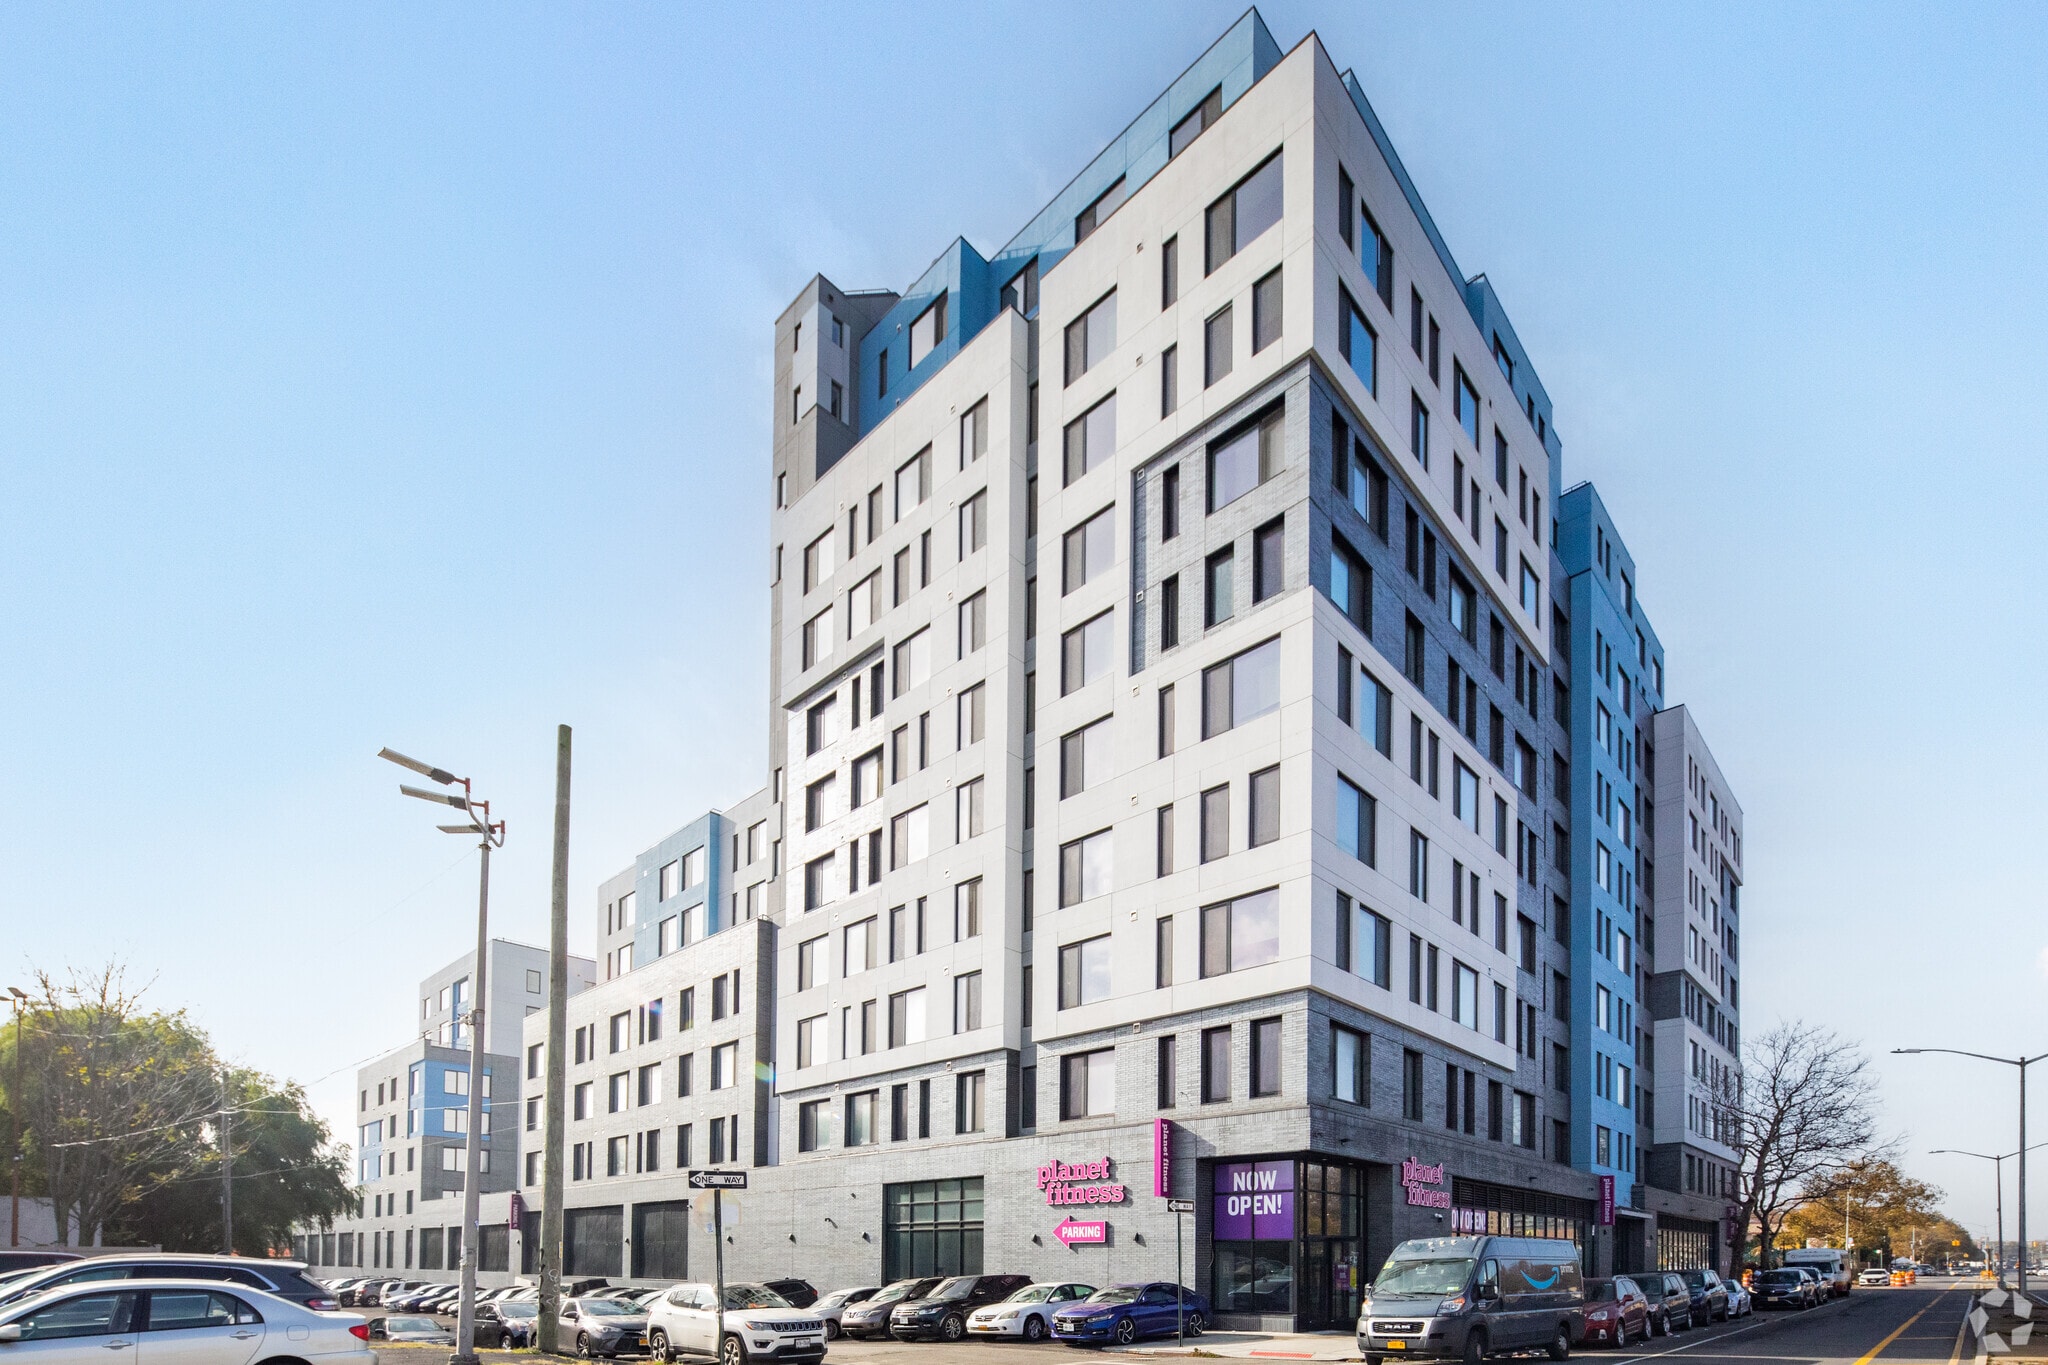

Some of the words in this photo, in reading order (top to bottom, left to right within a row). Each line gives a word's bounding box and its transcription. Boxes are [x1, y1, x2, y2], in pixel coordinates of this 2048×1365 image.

[1036, 1156, 1109, 1188] planet
[1233, 1170, 1277, 1191] NOW
[1402, 1157, 1443, 1186] planet
[1046, 1182, 1125, 1204] fitness
[1408, 1181, 1450, 1208] fitness
[1228, 1194, 1282, 1216] OPEN!
[1062, 1226, 1100, 1238] PARKING
